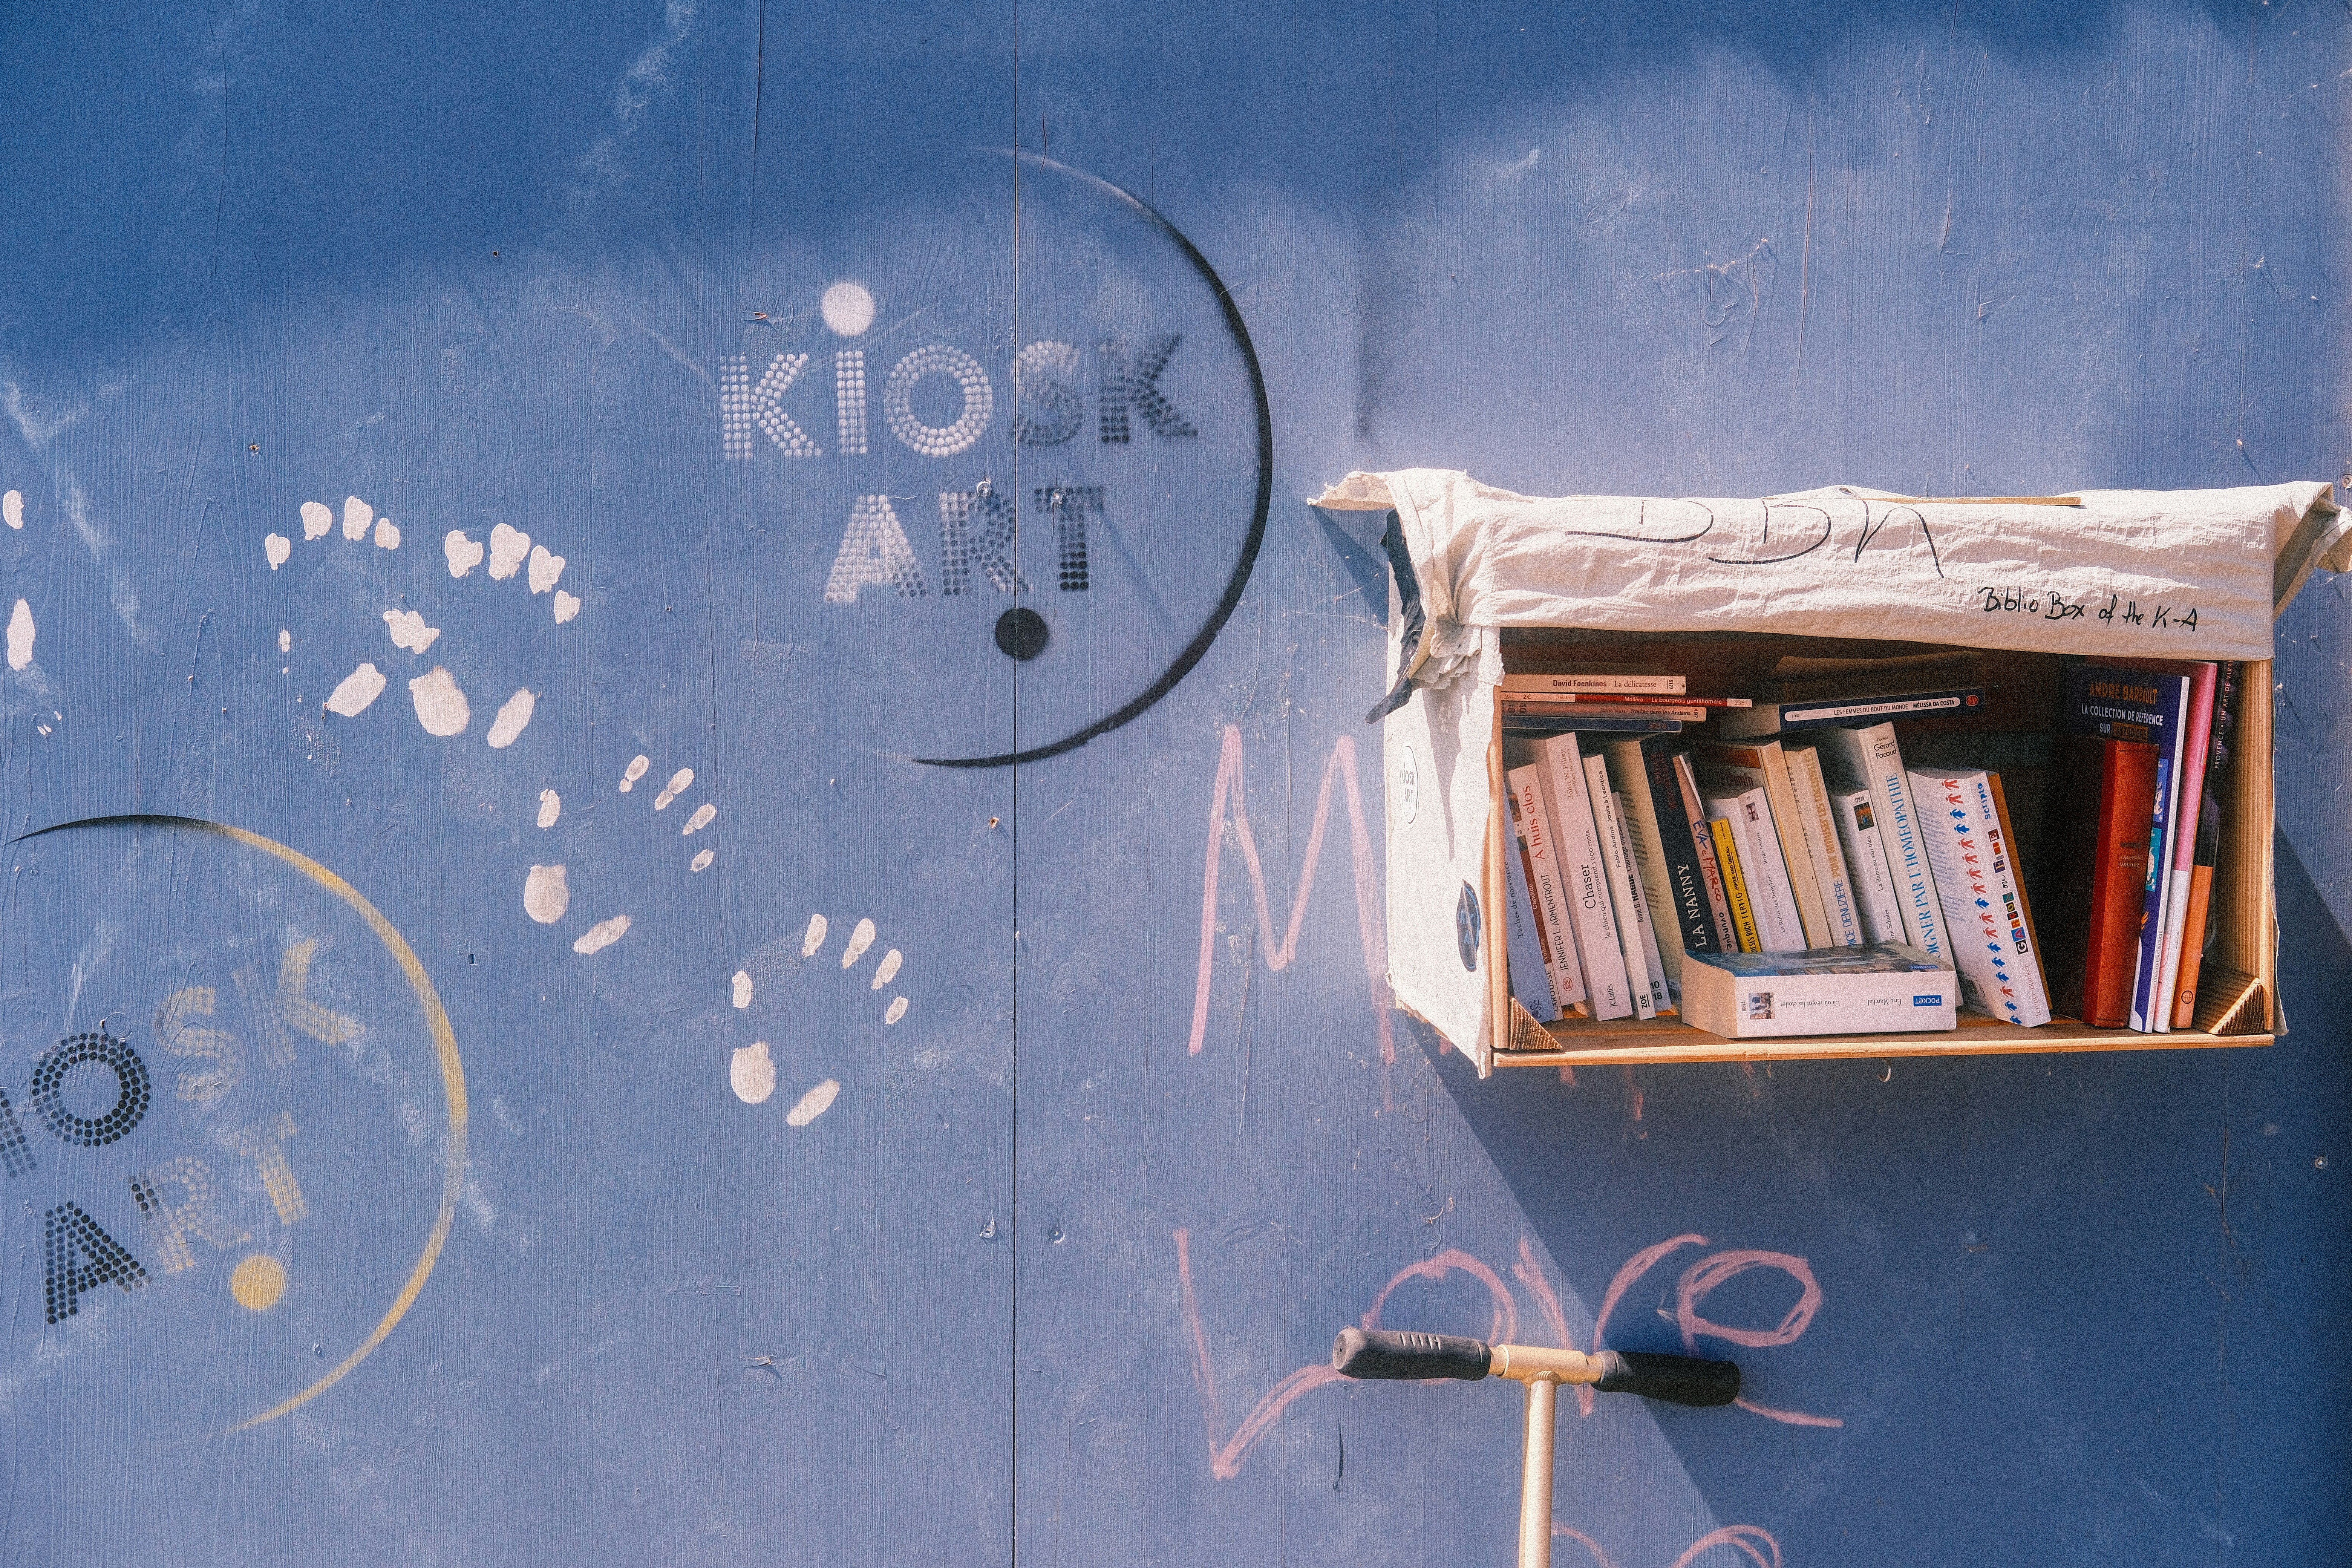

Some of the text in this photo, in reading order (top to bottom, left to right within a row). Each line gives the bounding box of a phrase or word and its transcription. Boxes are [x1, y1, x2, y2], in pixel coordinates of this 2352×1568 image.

[825, 483, 1105, 604] ART
[1978, 586, 2038, 612] Biblio
[2045, 591, 2084, 620] Box
[2098, 594, 2118, 628] of
[2122, 601, 2144, 625] the
[2090, 680, 2158, 704] ANDRÉ BARBAULT
[2081, 704, 2164, 726] LA COLLECTION DE RÉFÉRENCE
[2214, 731, 2223, 769] PROVENCE
[2221, 710, 2226, 721] UN
[2224, 682, 2230, 691] DE
[2099, 723, 2111, 734] SUR
[1874, 738, 1895, 751] Gérard
[1876, 747, 1897, 759] Pacaud
[1563, 771, 1570, 780] W.
[1404, 789, 1413, 803] ART
[1523, 786, 1545, 859] À huis clos
[1816, 803, 1827, 818] LES
[1819, 819, 1835, 854] AMUSER
[1886, 773, 1921, 878] L'HOMÉOPATHIE
[1828, 855, 1841, 878] POUR
[1581, 864, 1596, 909] Chaser
[1591, 866, 1603, 899] comprend
[1693, 820, 1709, 849] EVA
[1703, 858, 1721, 901] MARCO
[1719, 912, 1732, 950] ovunque
[1767, 873, 1776, 899] Templiers
[1878, 883, 1883, 892] La
[1911, 881, 1928, 908] PAR
[2002, 874, 2008, 889] ou
[1504, 862, 1523, 939] Taches de naissance
[1529, 883, 1537, 910] Candide
[1541, 874, 1559, 925] ARMENTROUT
[1678, 864, 1707, 948] LA NANNY
[1736, 893, 1749, 919] FERTIG
[1833, 879, 1853, 928] DENUZIÈRE
[1602, 913, 1611, 931] chien
[1743, 921, 1753, 936] BUCH
[1884, 909, 1893, 929] Scholes
[1554, 936, 1569, 971] JENNIFER
[1546, 970, 1559, 1012] LAROUSSE
[1650, 981, 1660, 989] 10
[1653, 992, 1663, 1001] 18
[2024, 965, 2041, 1017] Terence Blacker
[1640, 994, 1648, 1009] ZOE
